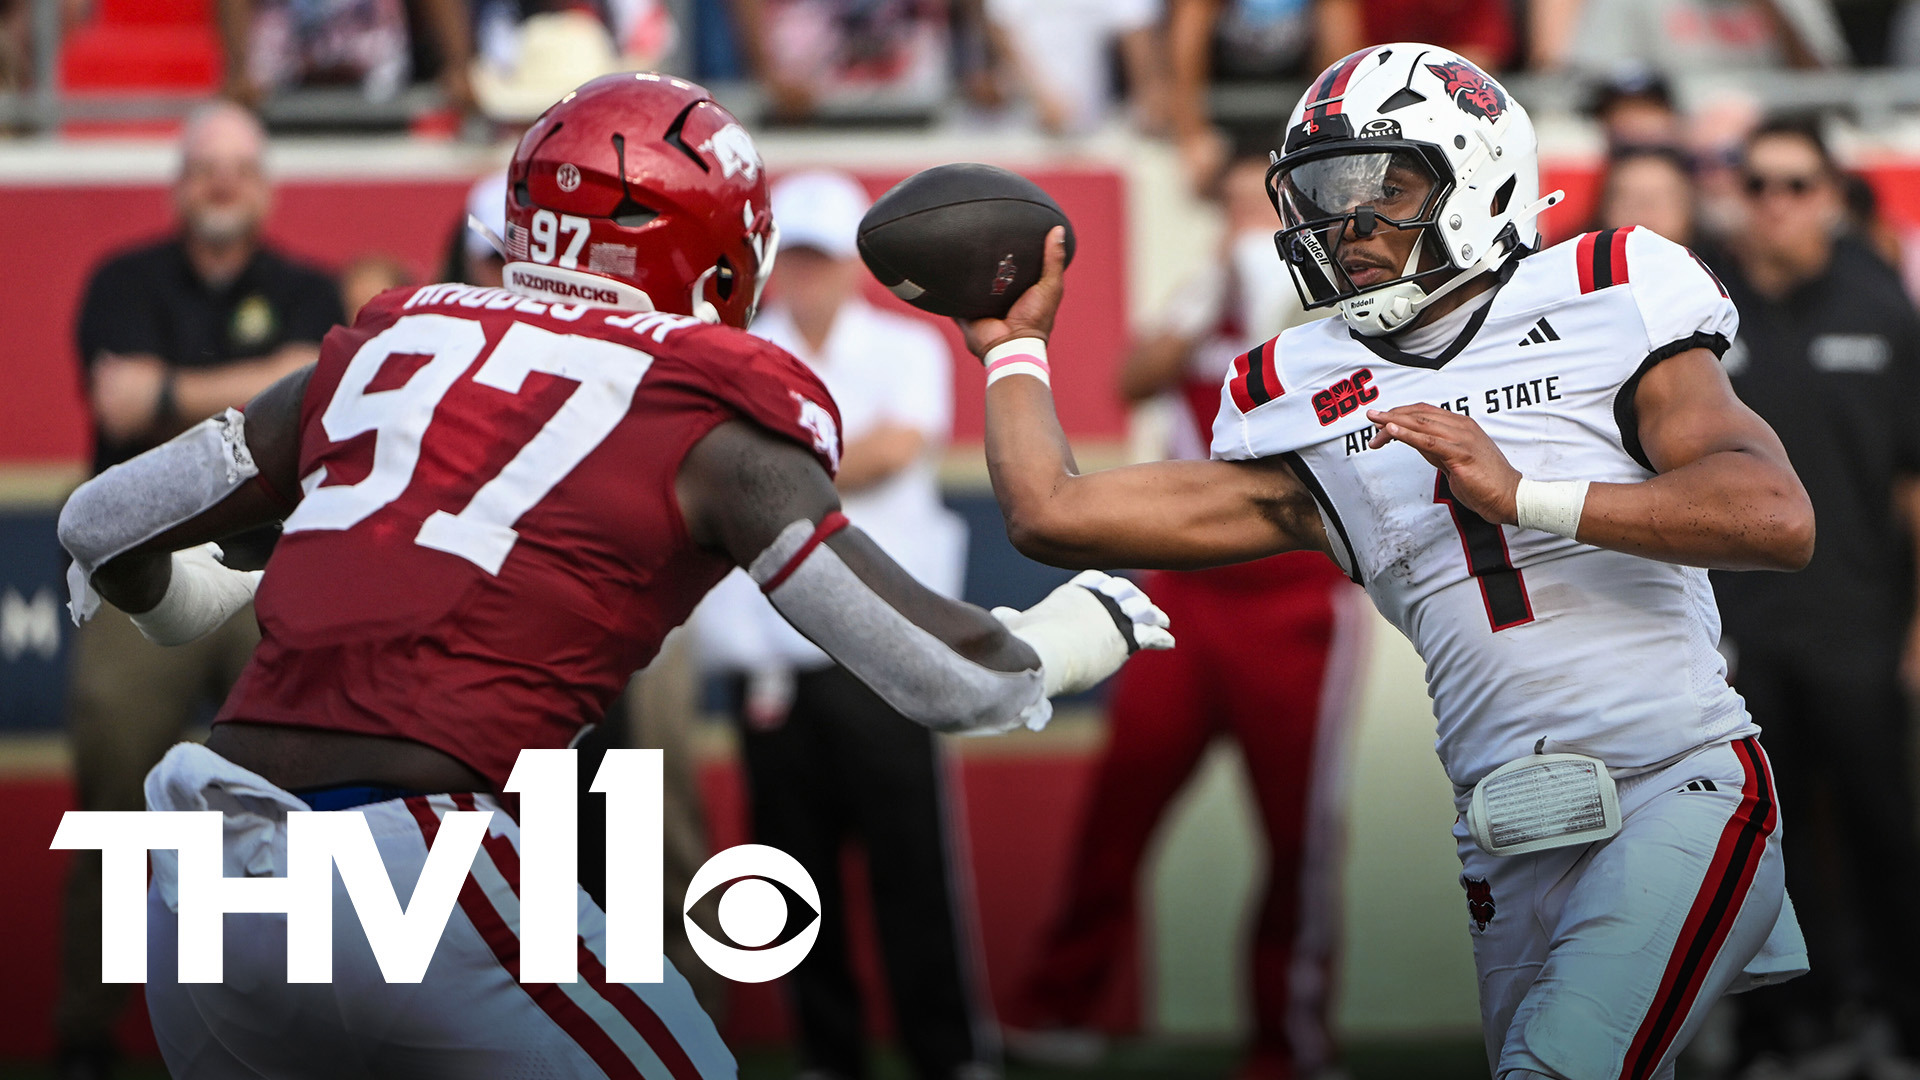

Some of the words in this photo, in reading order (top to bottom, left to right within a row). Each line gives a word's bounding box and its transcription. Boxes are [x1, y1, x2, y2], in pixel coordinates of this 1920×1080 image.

[1360, 127, 1401, 139] OAKLEY
[530, 209, 591, 270] 97
[1301, 233, 1331, 266] Riddell
[512, 271, 619, 304] RAZORBACKS
[1350, 298, 1375, 310] Riddell
[1311, 368, 1380, 427] SBC
[1485, 375, 1562, 414] STATE
[282, 313, 655, 577] 97
[1433, 468, 1535, 633] 1
